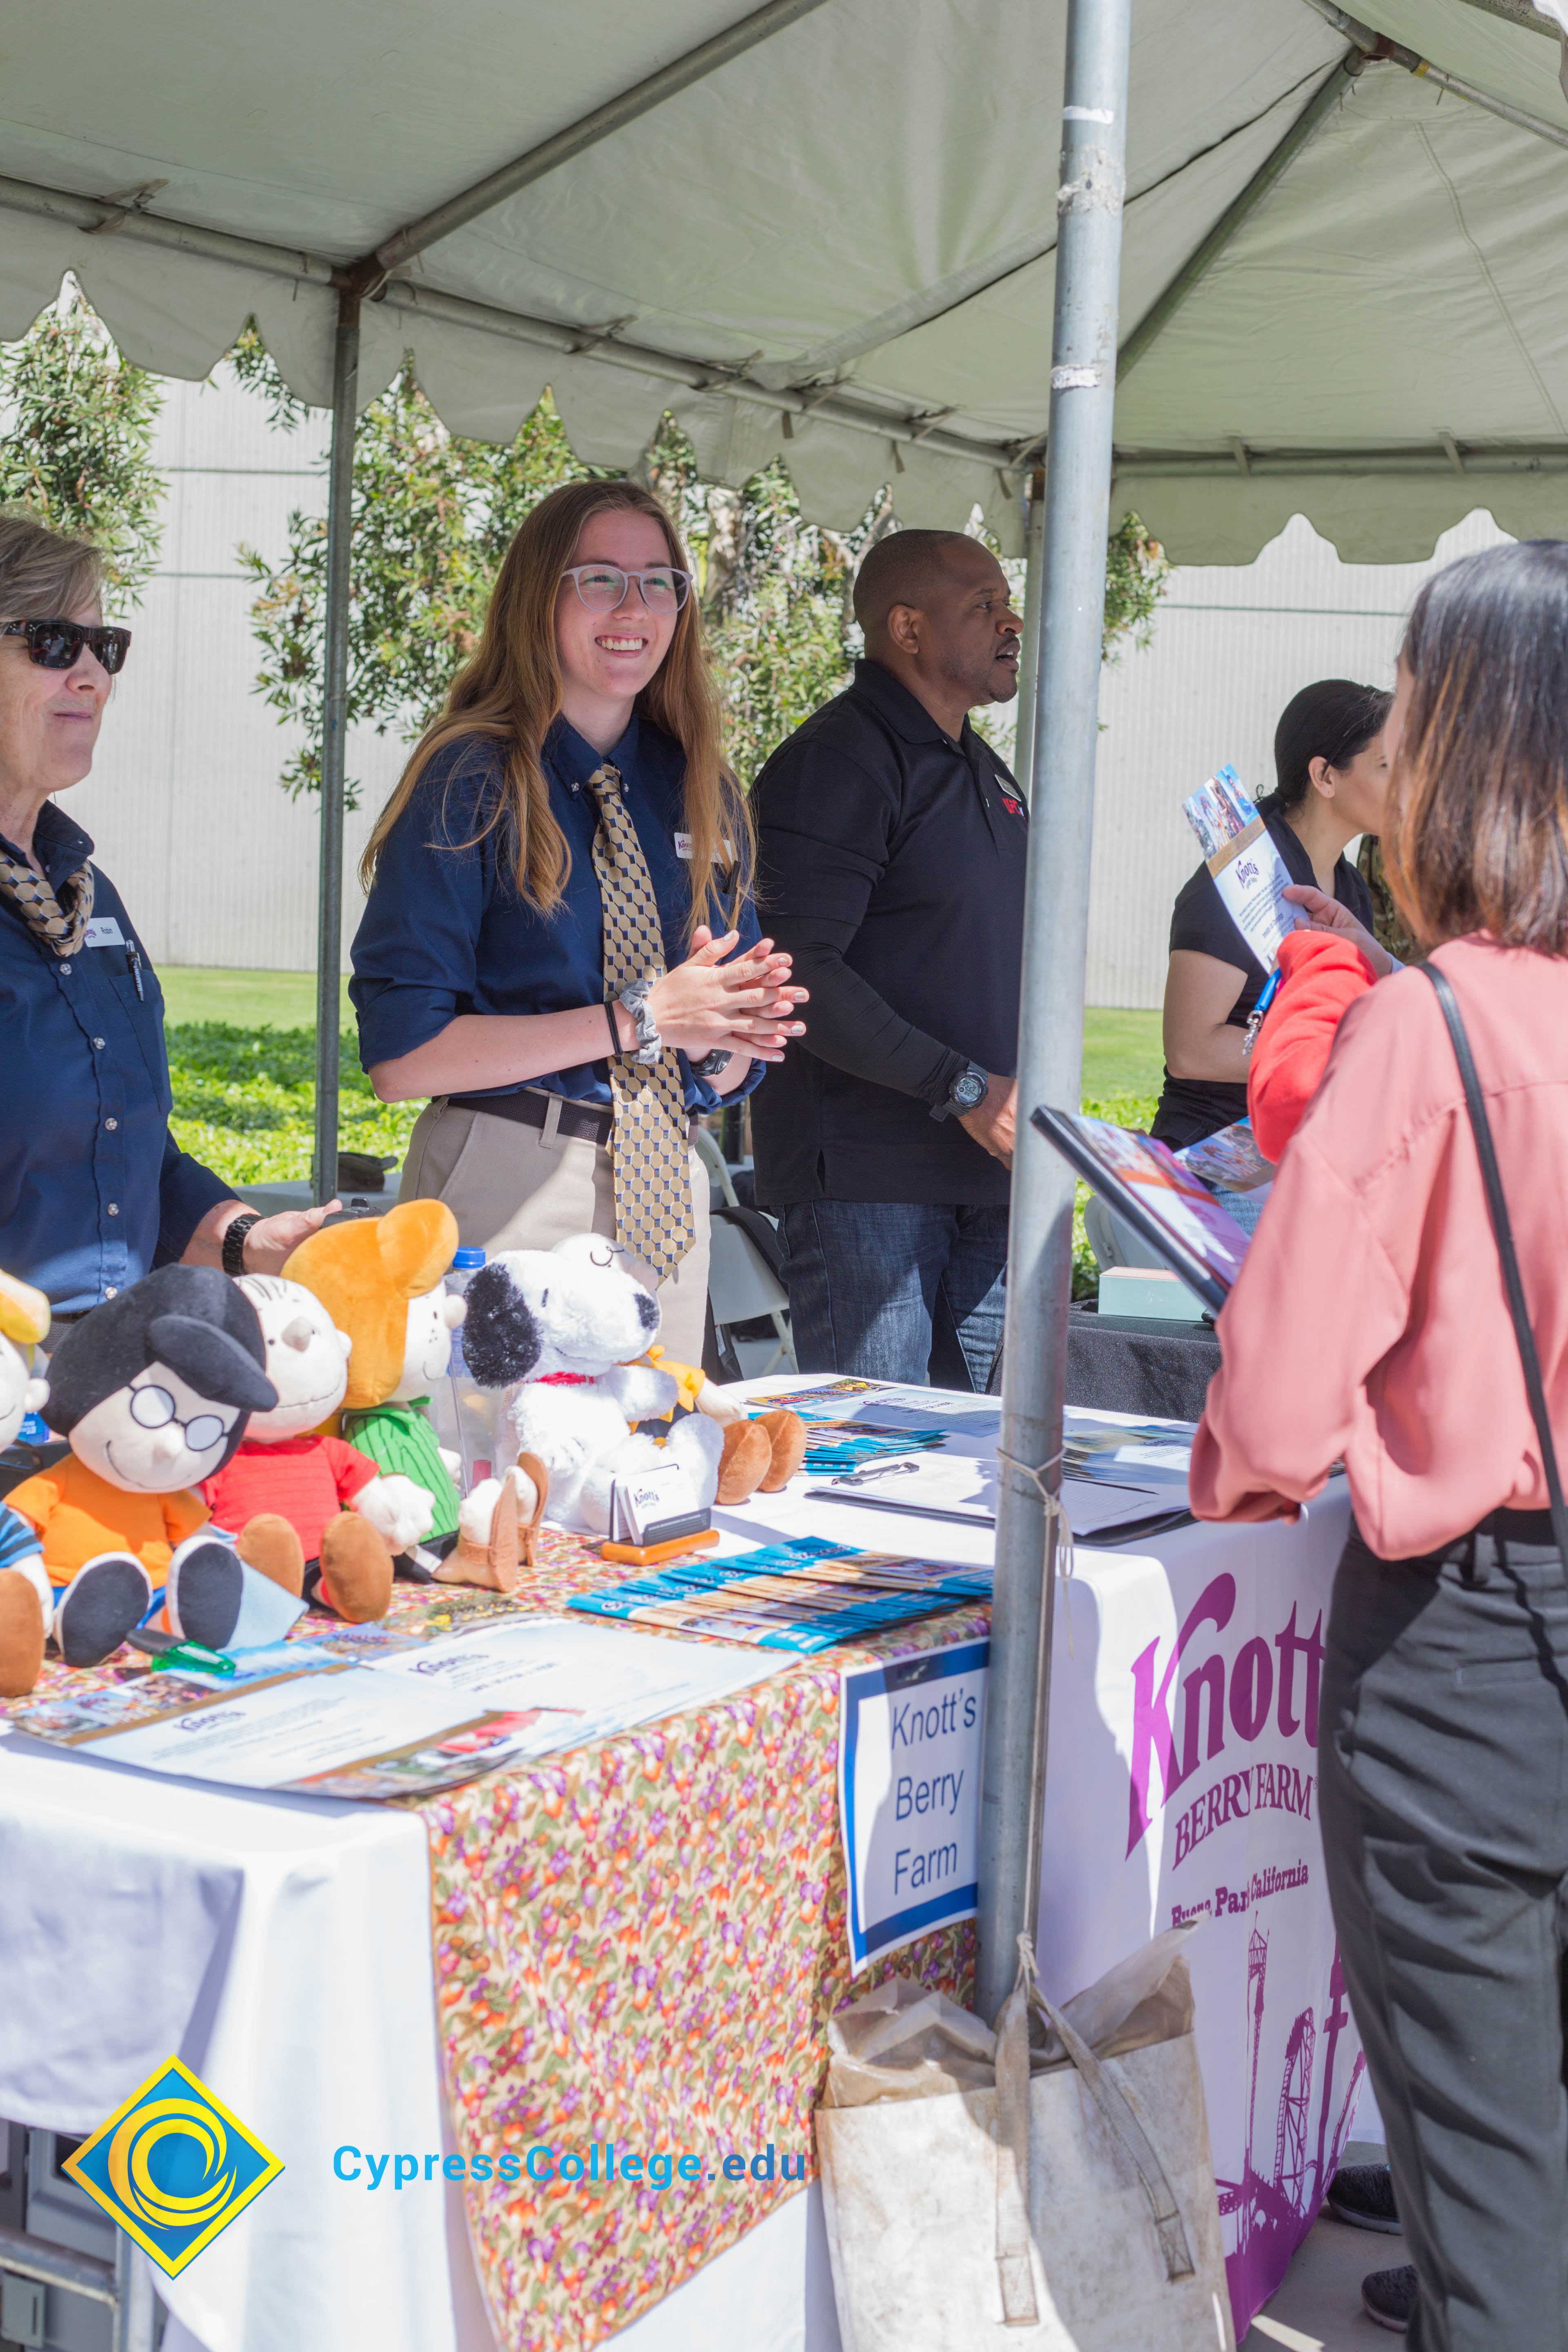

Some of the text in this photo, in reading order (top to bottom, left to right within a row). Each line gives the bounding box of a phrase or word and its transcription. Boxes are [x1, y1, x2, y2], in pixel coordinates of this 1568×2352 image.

[891, 1688, 976, 1750] Knott's
[896, 1770, 964, 1822] Berry
[1172, 1766, 1254, 1871] BERRY
[895, 1842, 957, 1895] Farm
[1251, 1859, 1309, 1902] California
